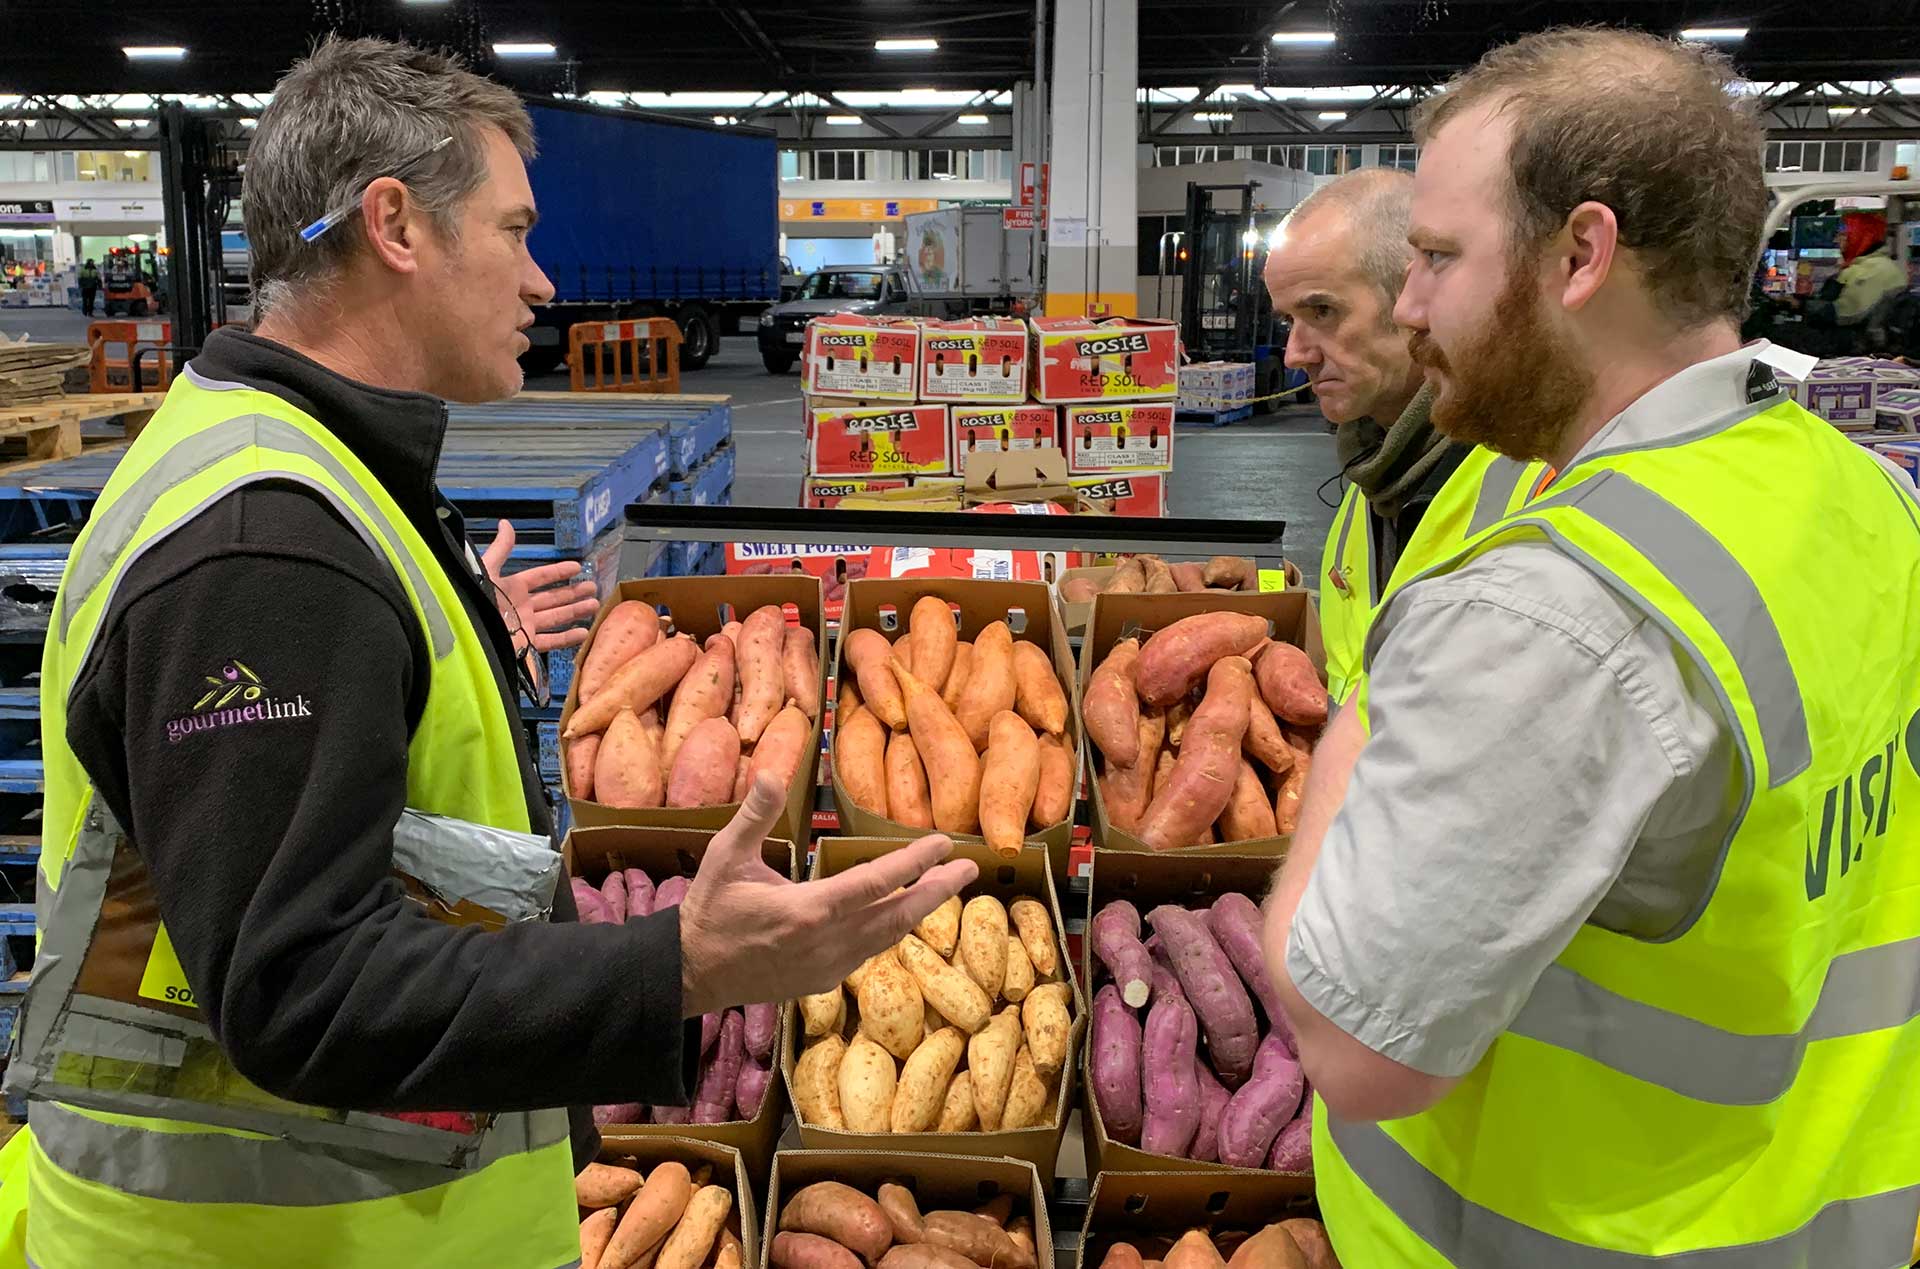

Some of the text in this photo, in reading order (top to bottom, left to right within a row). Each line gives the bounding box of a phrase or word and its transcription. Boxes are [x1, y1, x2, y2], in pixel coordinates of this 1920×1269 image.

[822, 335, 865, 346] ROSIE
[869, 335, 889, 345] RED
[930, 338, 973, 350] ROSIE
[977, 338, 998, 347] RED
[1080, 334, 1146, 355] ROSIE
[1080, 374, 1146, 388] RED SOIL
[847, 413, 914, 432] ROSIE
[961, 413, 1049, 426] ROSIE RED SOIL
[1077, 410, 1167, 424] ROSIE RED SOIL
[849, 450, 914, 464] RED SOIL
[814, 485, 854, 496] ROSIE
[1077, 481, 1129, 499] OSIE
[742, 543, 799, 556] SWEET
[166, 694, 313, 742] gourmetlink
[1804, 710, 1920, 902] VISI
[165, 985, 194, 1003] SO
